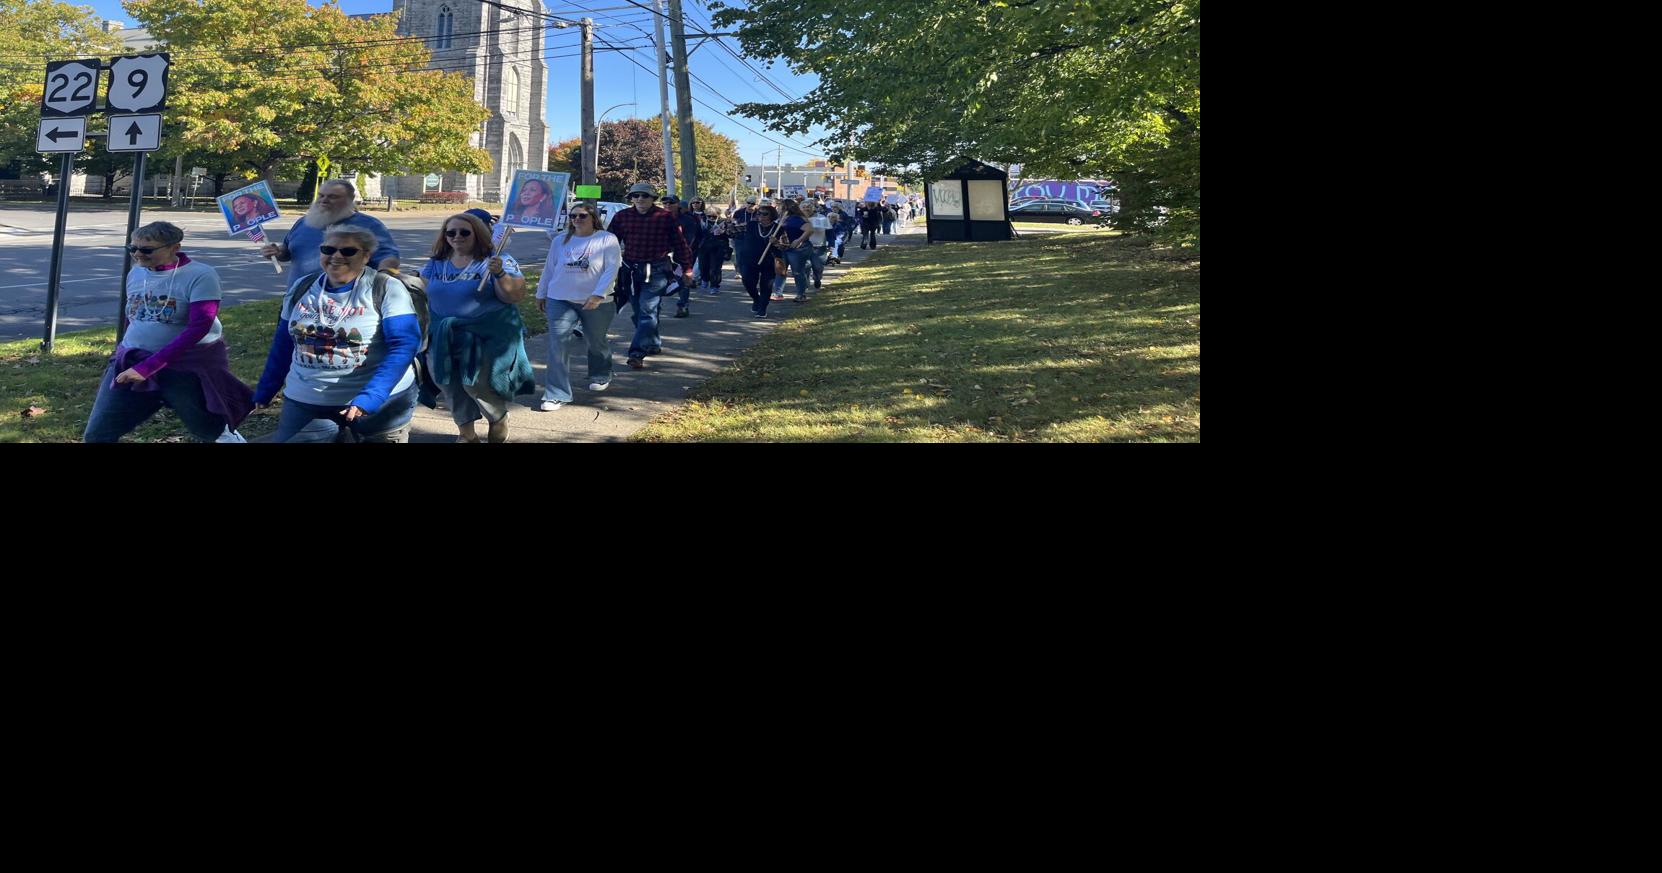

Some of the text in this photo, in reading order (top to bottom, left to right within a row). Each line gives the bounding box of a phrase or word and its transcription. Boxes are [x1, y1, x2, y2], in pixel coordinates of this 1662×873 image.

[48, 72, 93, 102] 22
[127, 69, 148, 99] 9
[518, 172, 539, 180] FOR
[232, 209, 277, 232] POPLE
